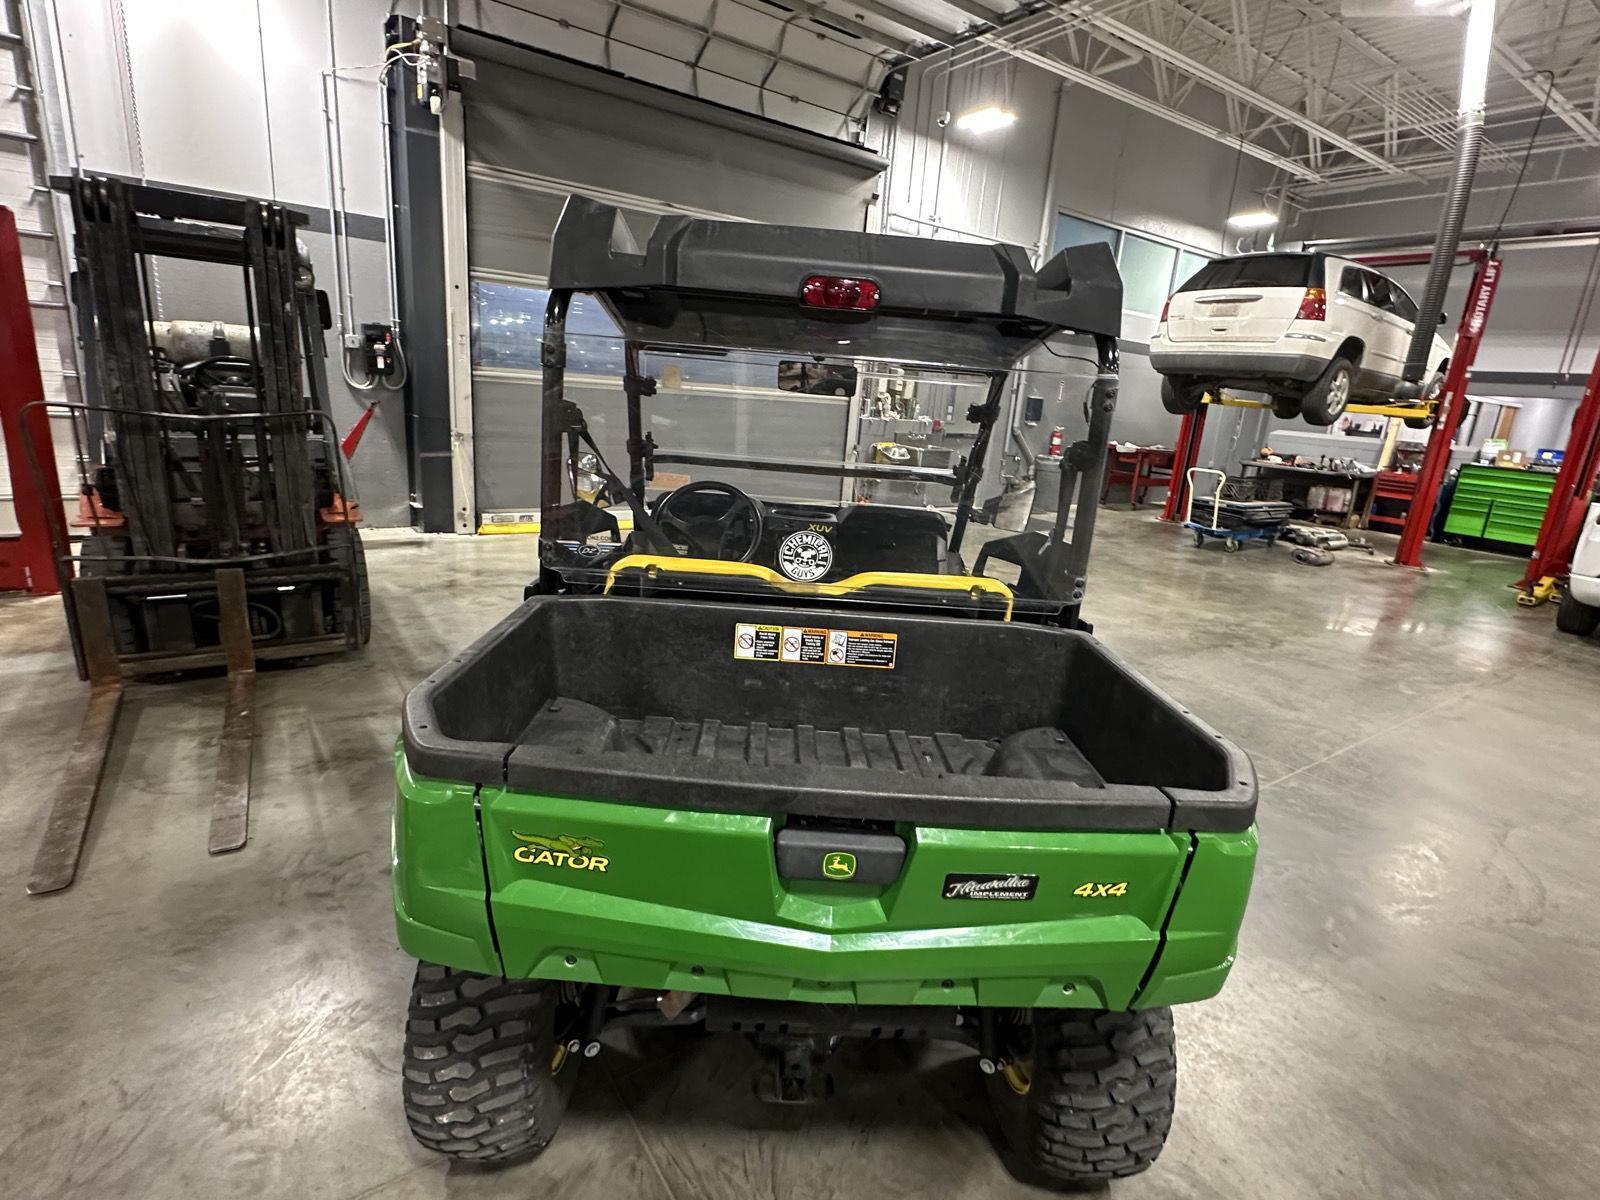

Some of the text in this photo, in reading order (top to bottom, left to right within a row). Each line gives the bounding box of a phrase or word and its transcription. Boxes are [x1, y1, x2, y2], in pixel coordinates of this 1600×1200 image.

[1483, 260, 1499, 282] LIFT
[807, 523, 833, 533] XUV
[784, 534, 829, 560] CHEMICAL
[791, 566, 815, 579] GUYS
[513, 846, 609, 872] GATOR
